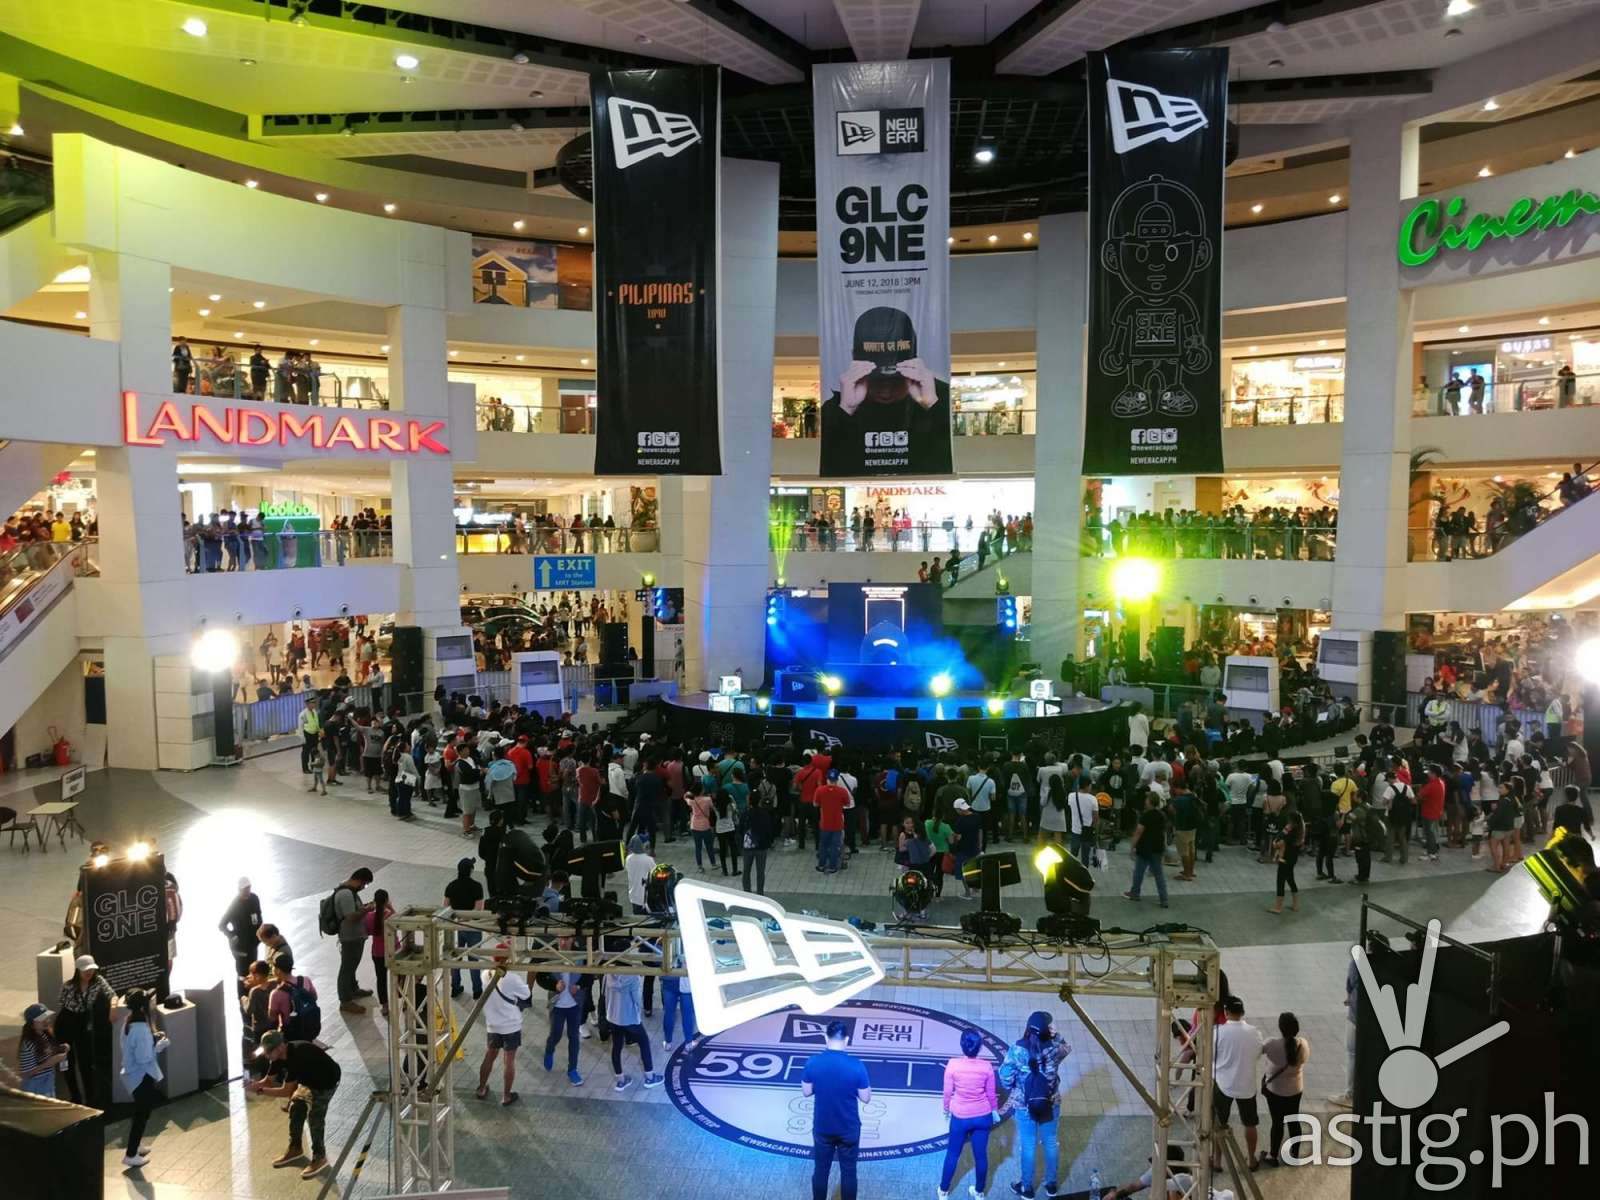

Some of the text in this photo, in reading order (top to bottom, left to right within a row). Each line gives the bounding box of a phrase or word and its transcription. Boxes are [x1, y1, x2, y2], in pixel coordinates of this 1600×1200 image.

[886, 118, 918, 132] NEW
[886, 130, 918, 145] ERA
[836, 184, 929, 224] GLC
[840, 224, 926, 264] 9NE
[845, 279, 865, 289] JUNE
[619, 282, 694, 305] PILIPINAS
[1136, 312, 1177, 328] GLC
[122, 390, 451, 455] LANDMARK
[1130, 456, 1177, 465] NEWERACAP.PH
[866, 486, 947, 498] LANDMARK
[557, 559, 592, 571] EXIT
[94, 885, 159, 919] GLC
[97, 908, 159, 943] 9NE
[863, 1023, 913, 1034] NEW
[862, 1032, 912, 1042] ERA
[917, 1142, 935, 1152] THE
